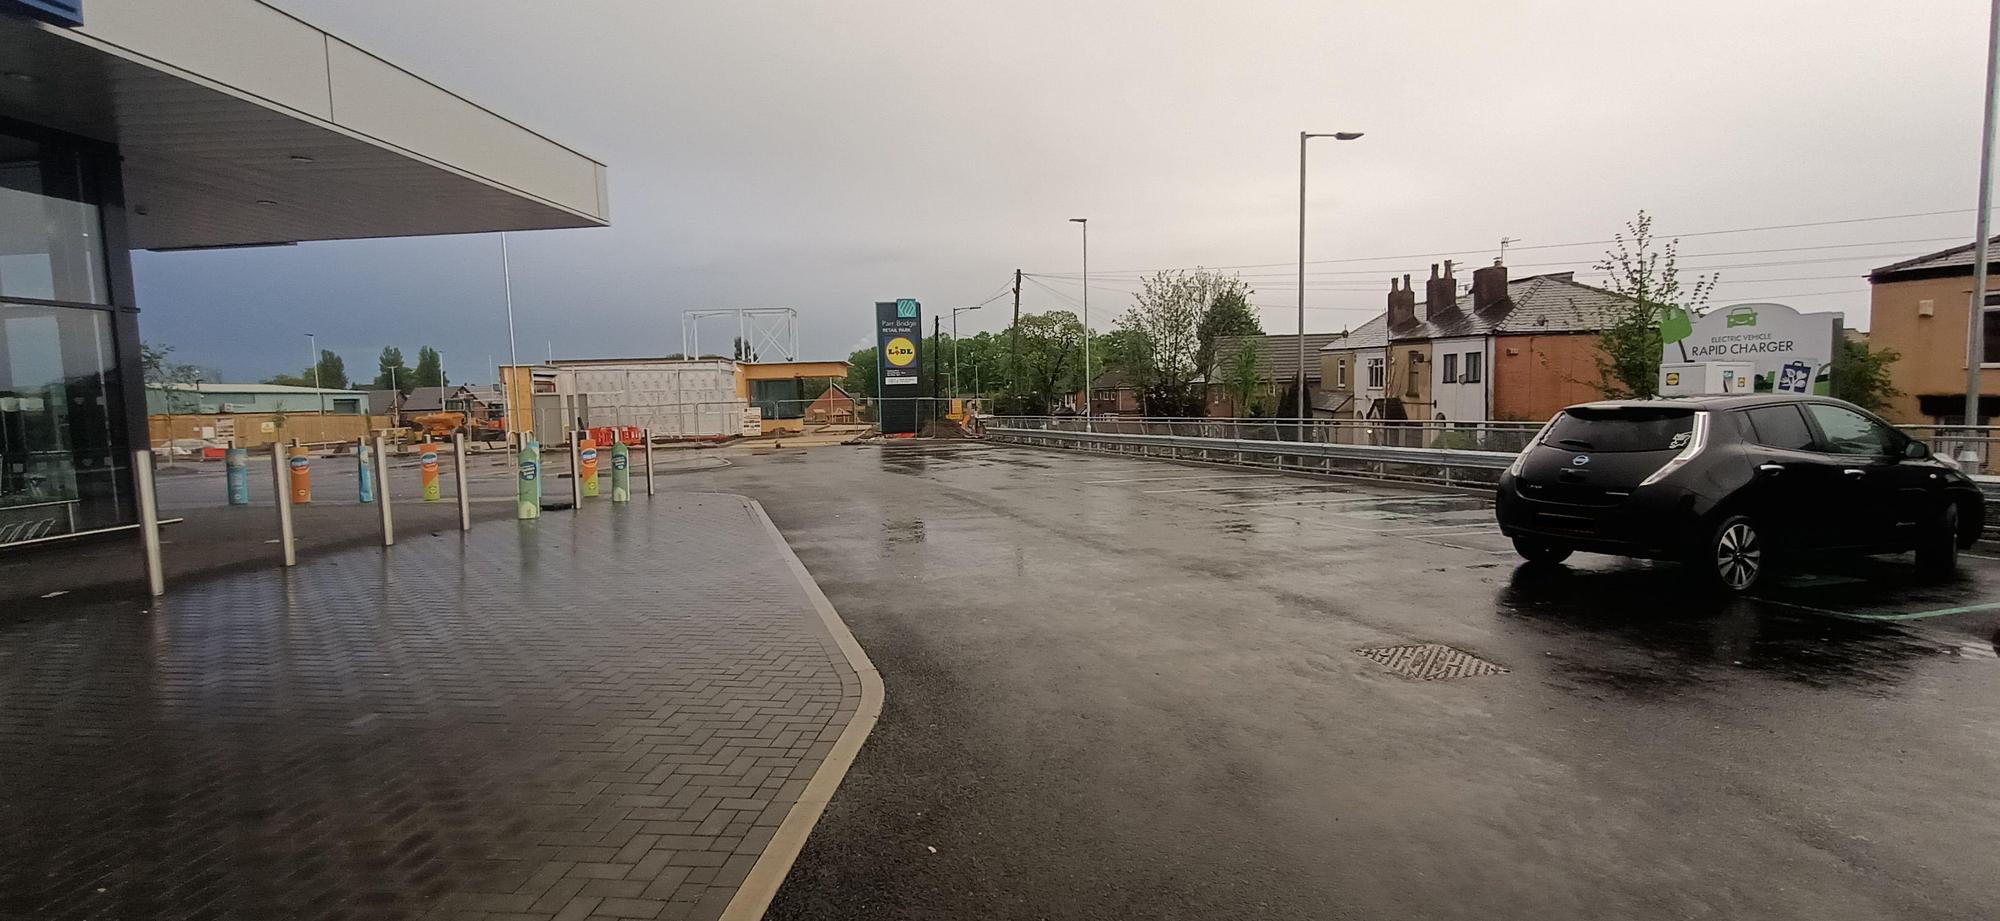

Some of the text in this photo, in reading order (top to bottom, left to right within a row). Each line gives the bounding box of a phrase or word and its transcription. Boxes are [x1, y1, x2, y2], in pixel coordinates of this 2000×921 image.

[896, 319, 917, 328] Bridge
[1711, 333, 1772, 343] ELECTRIC VEHICLE
[1692, 341, 1793, 356] RAPID CHARGER
